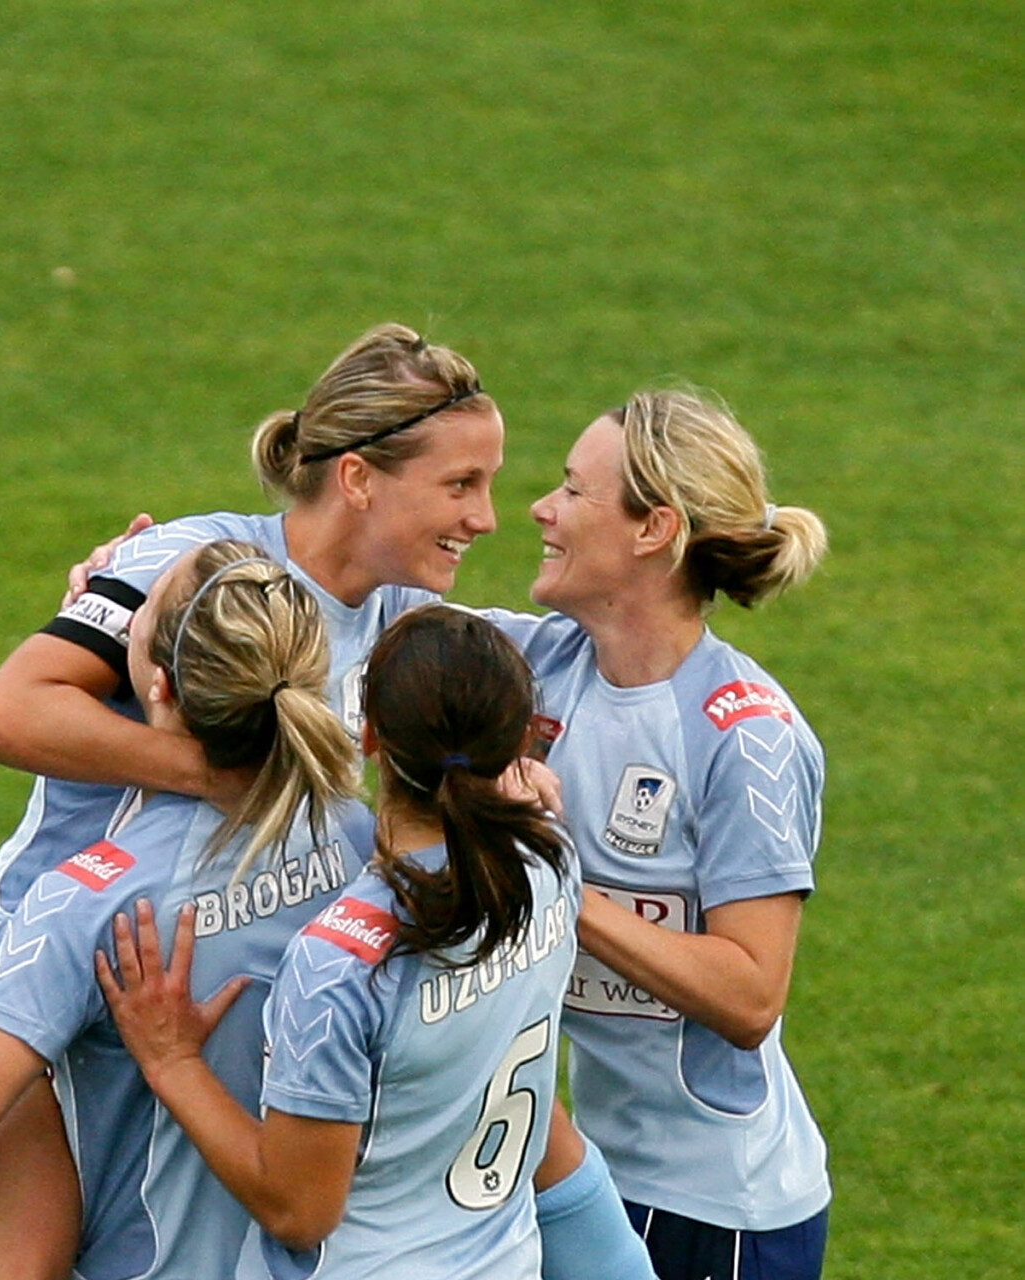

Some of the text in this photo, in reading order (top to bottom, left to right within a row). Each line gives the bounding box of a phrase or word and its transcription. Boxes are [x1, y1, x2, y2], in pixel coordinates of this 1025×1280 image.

[69, 599, 115, 626] AIN
[195, 840, 346, 937] BROGAN
[445, 1013, 551, 1211] 6
